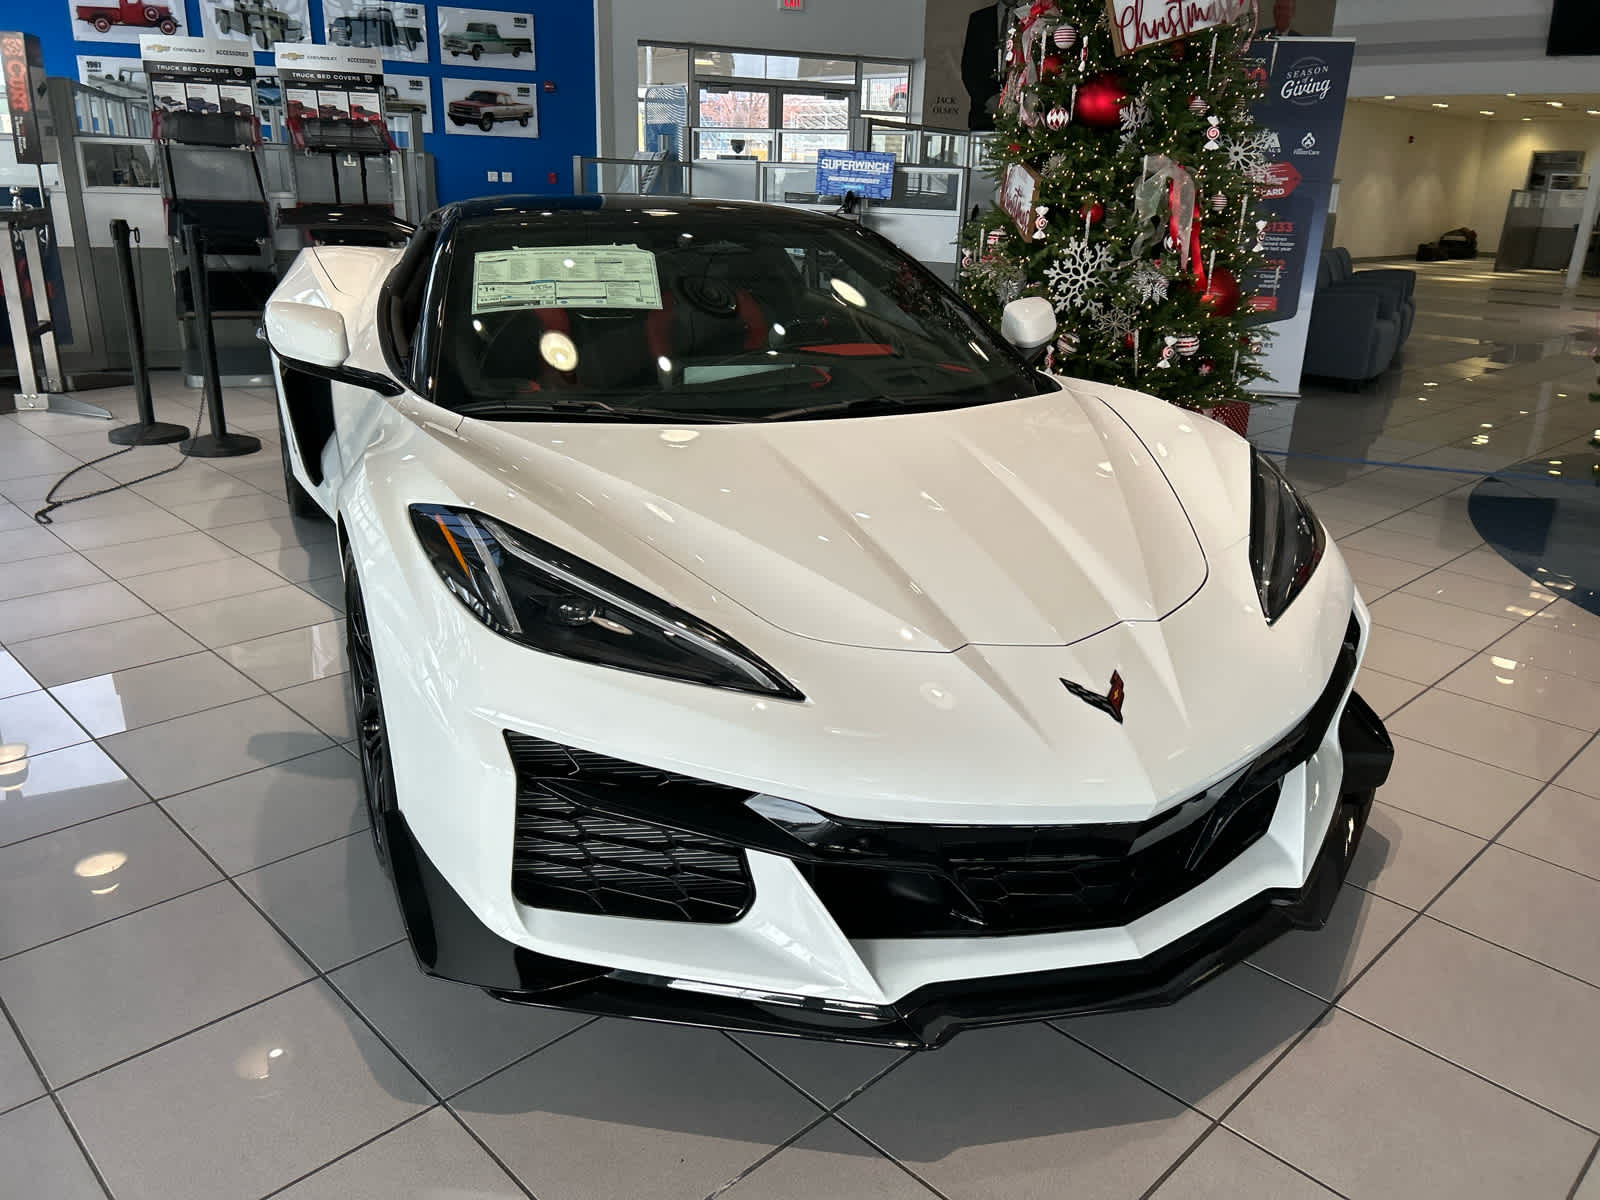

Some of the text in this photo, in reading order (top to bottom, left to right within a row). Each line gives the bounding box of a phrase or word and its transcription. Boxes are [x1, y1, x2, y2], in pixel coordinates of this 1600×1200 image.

[216, 49, 249, 57] ACCESSORIES
[347, 57, 377, 65] ACCESSORIES
[1286, 66, 1329, 79] SEASON
[7, 60, 29, 112] CURT
[1281, 79, 1331, 99] Giving
[936, 96, 957, 105] JACK
[821, 158, 890, 173] SUPERWINCH
